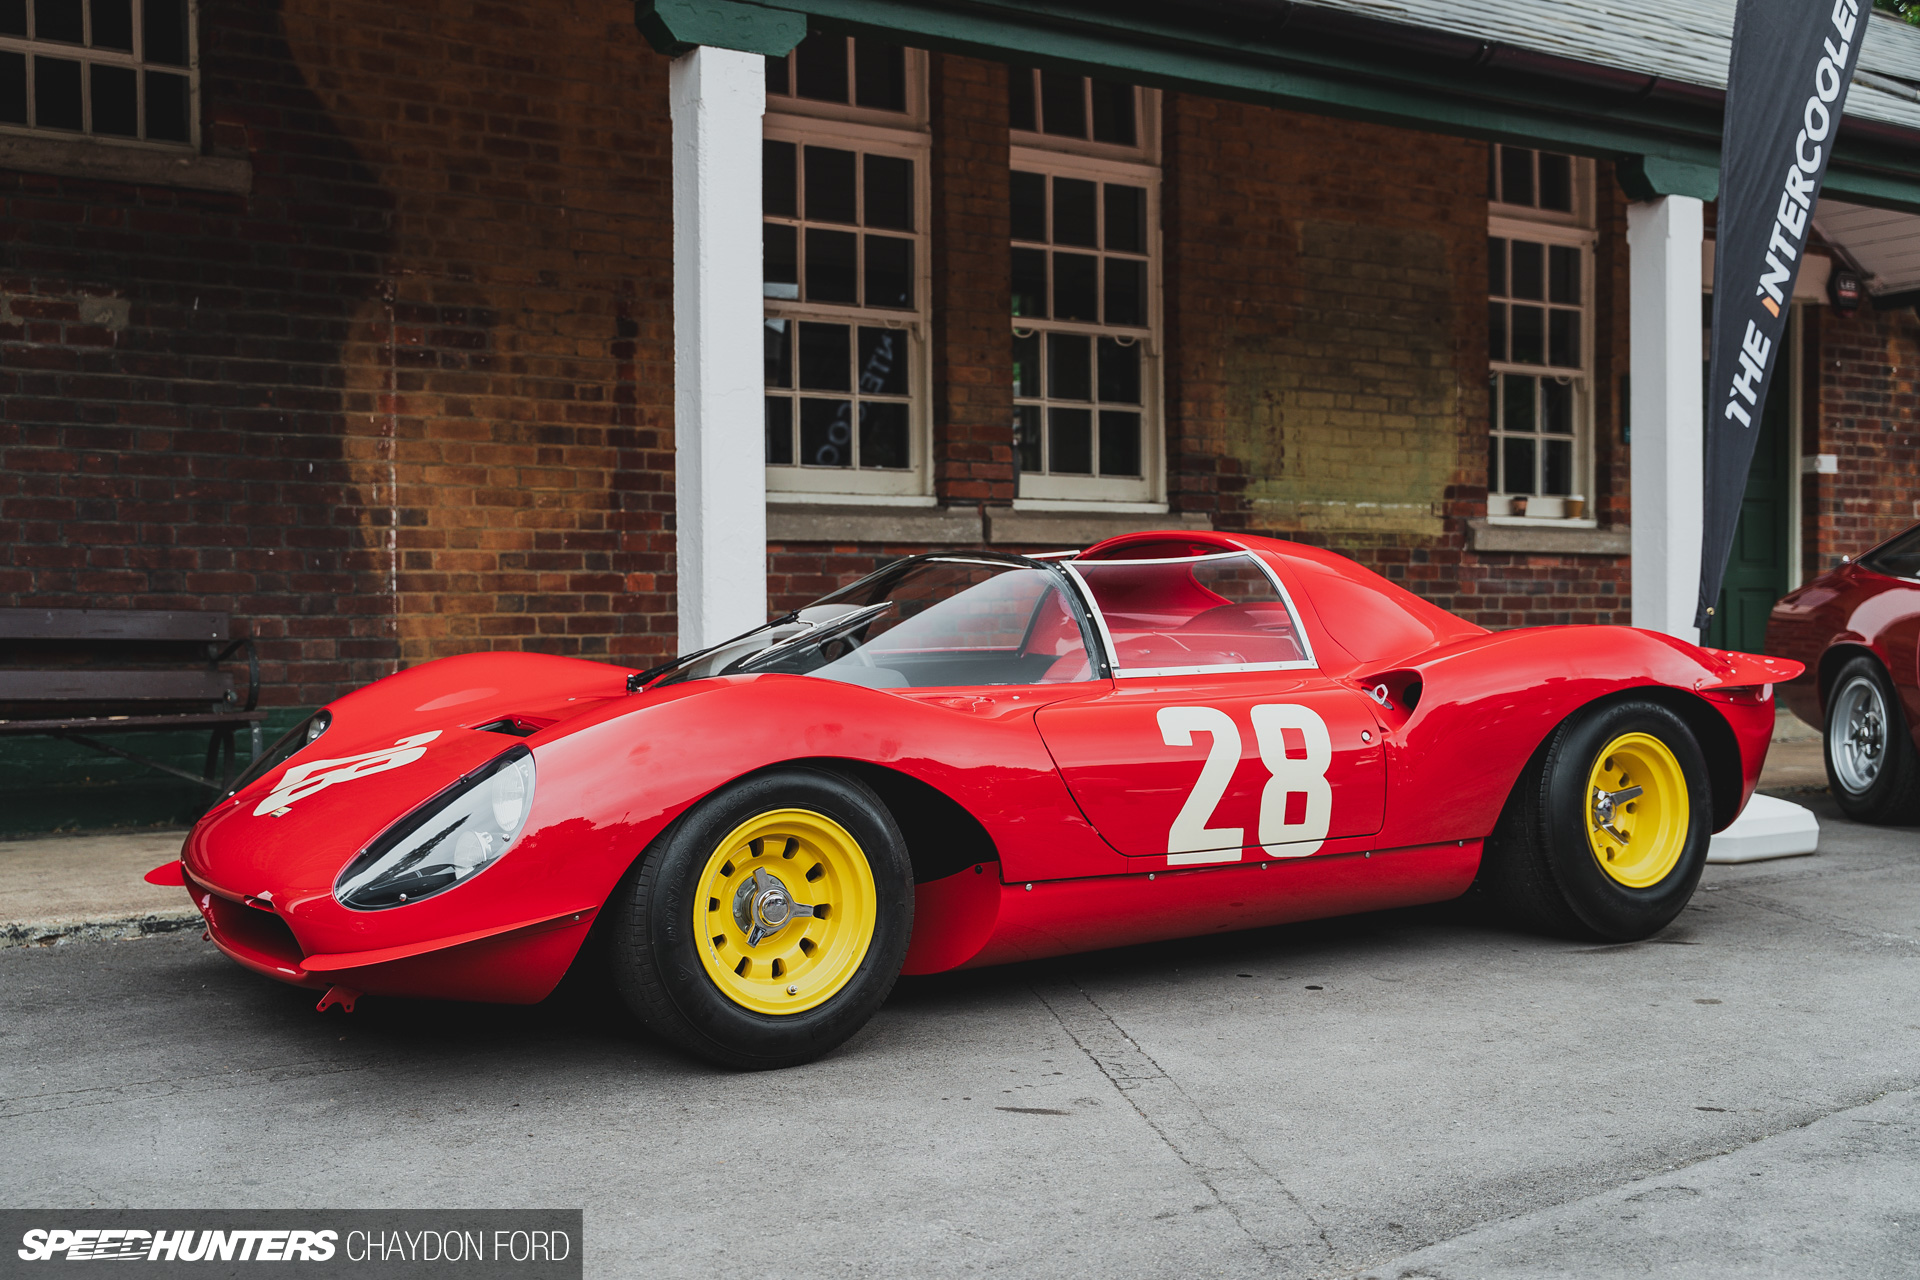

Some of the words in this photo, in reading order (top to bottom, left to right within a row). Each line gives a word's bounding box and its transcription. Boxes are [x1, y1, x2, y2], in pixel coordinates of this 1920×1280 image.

[1725, 319, 1771, 429] THE
[252, 729, 444, 817] 28
[1156, 703, 1333, 866] 28
[667, 847, 693, 943] DUNLOP
[700, 779, 773, 836] RACING
